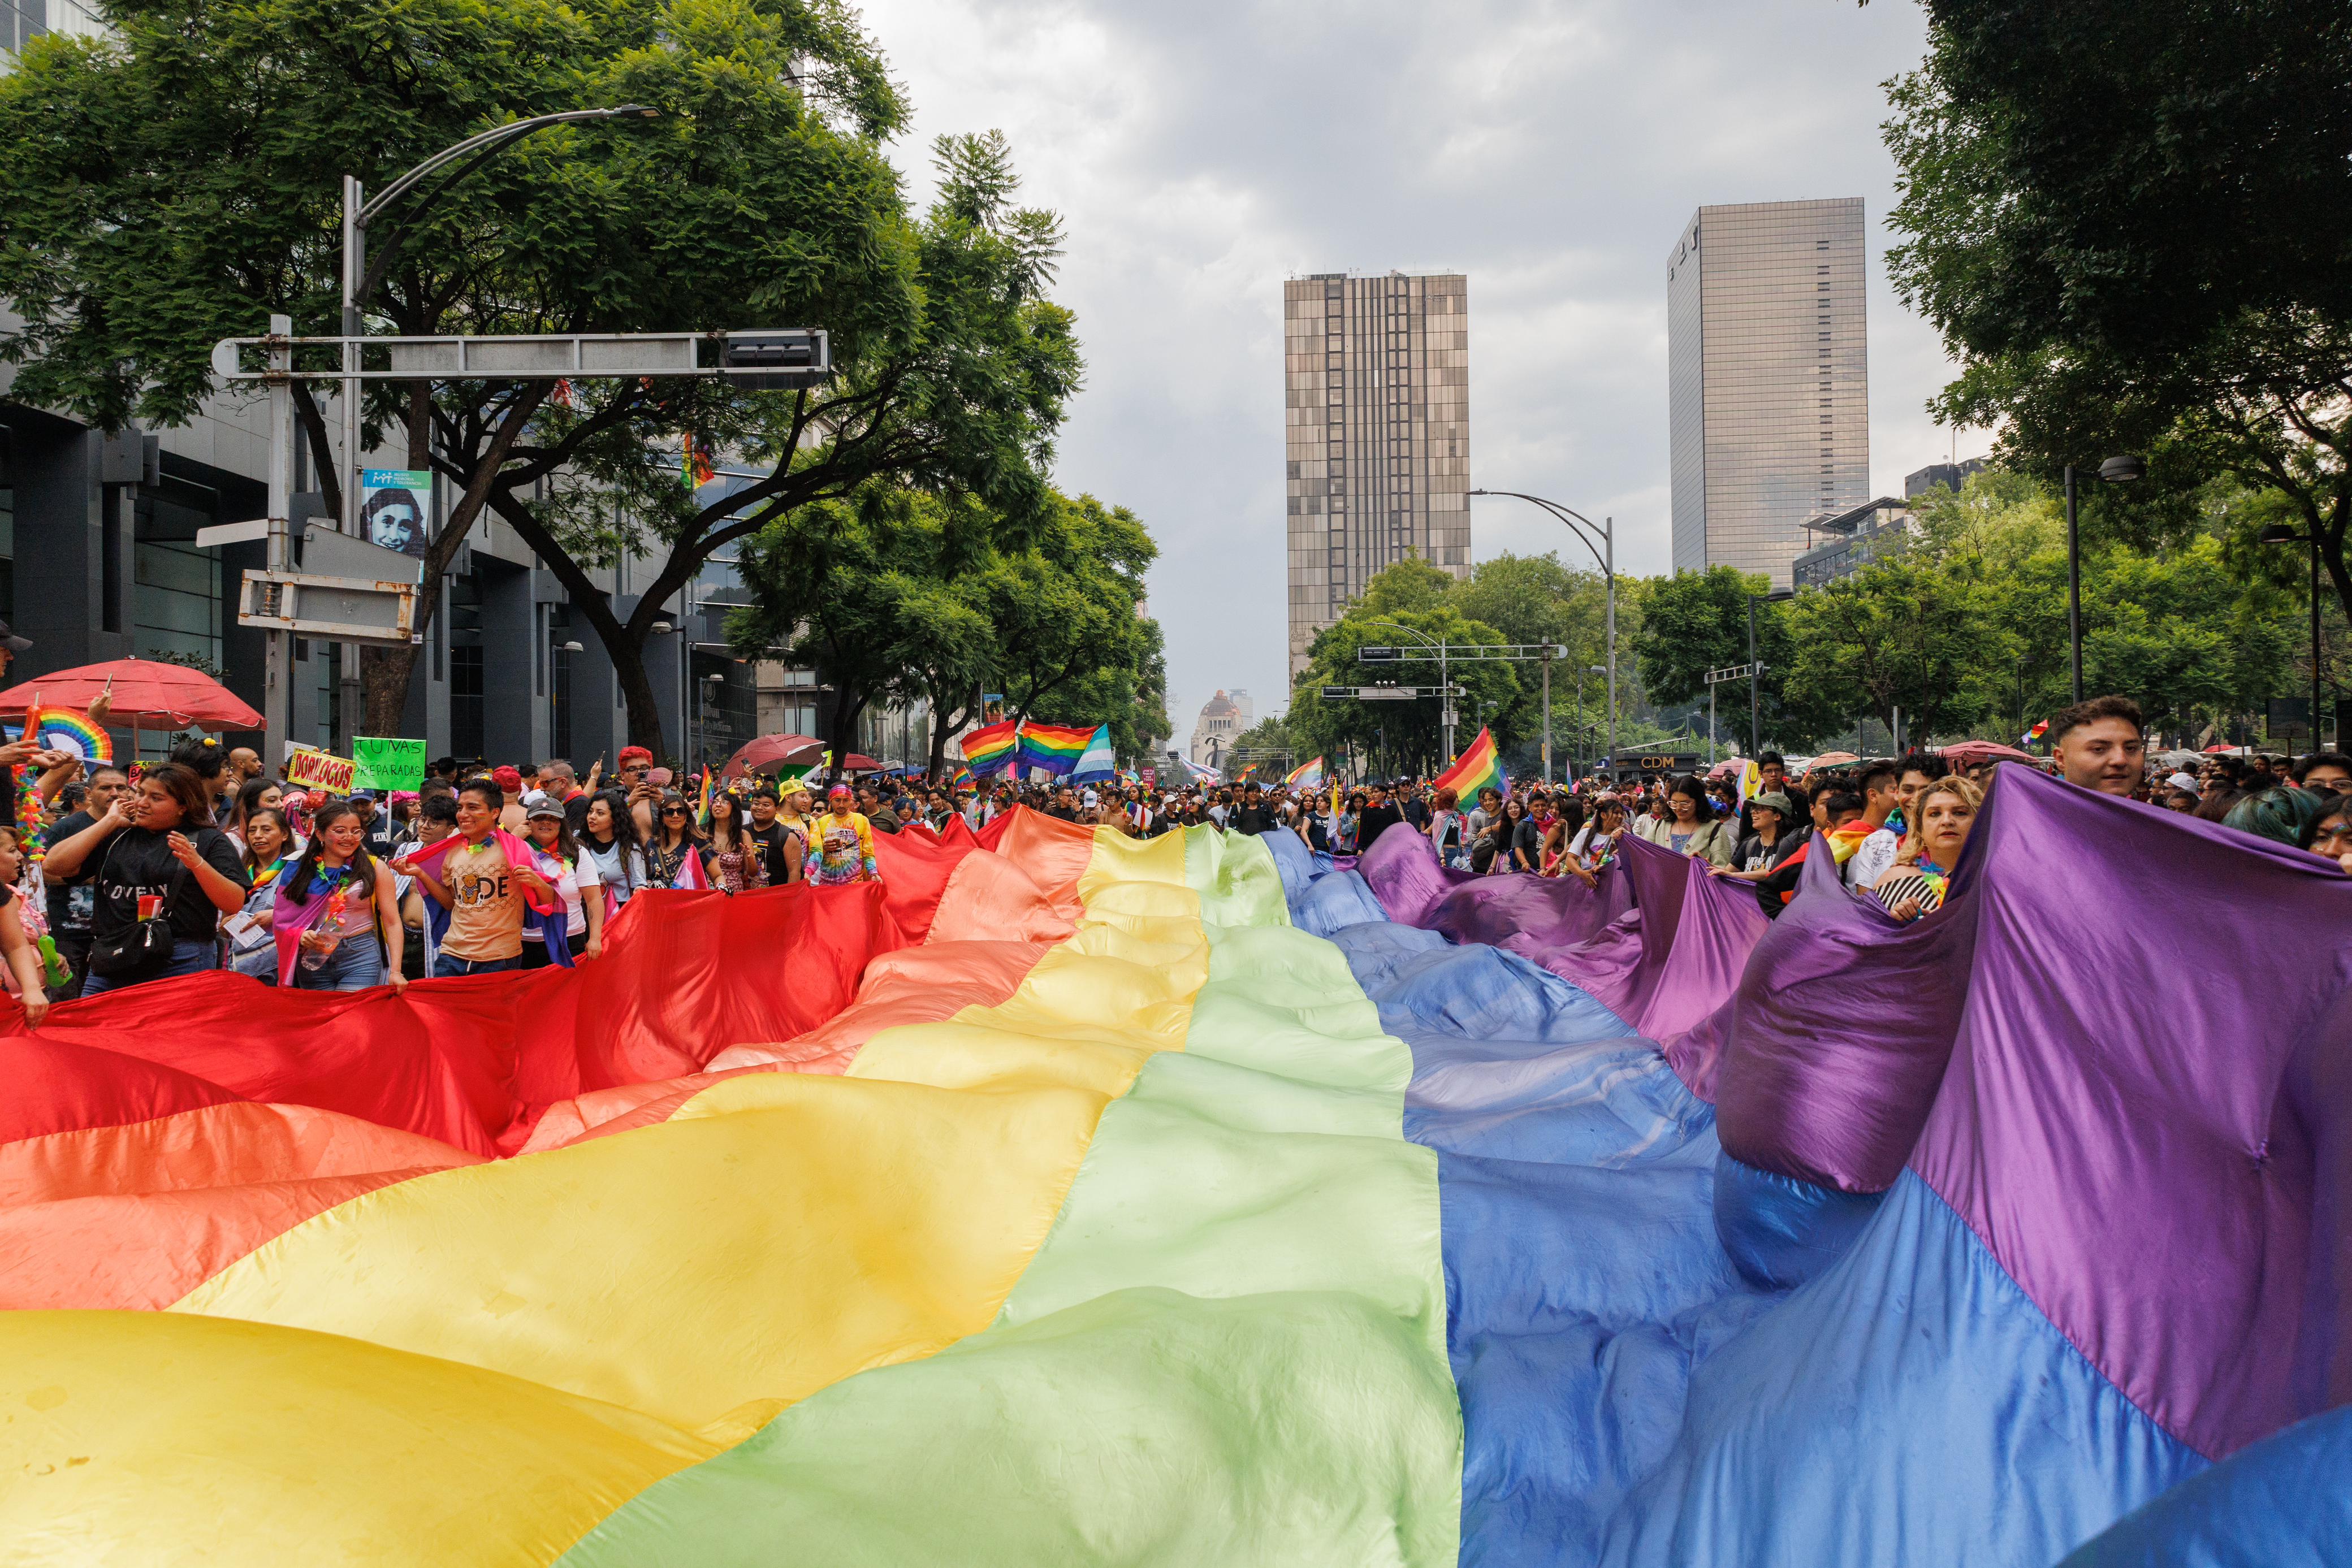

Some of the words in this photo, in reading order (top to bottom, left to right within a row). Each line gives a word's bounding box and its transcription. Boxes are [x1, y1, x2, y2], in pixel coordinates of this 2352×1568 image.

[354, 739, 422, 754] TUNAS
[1641, 756, 1674, 768] CDM
[294, 753, 353, 790] DORILOCOS
[355, 764, 422, 777] PREPARADAS
